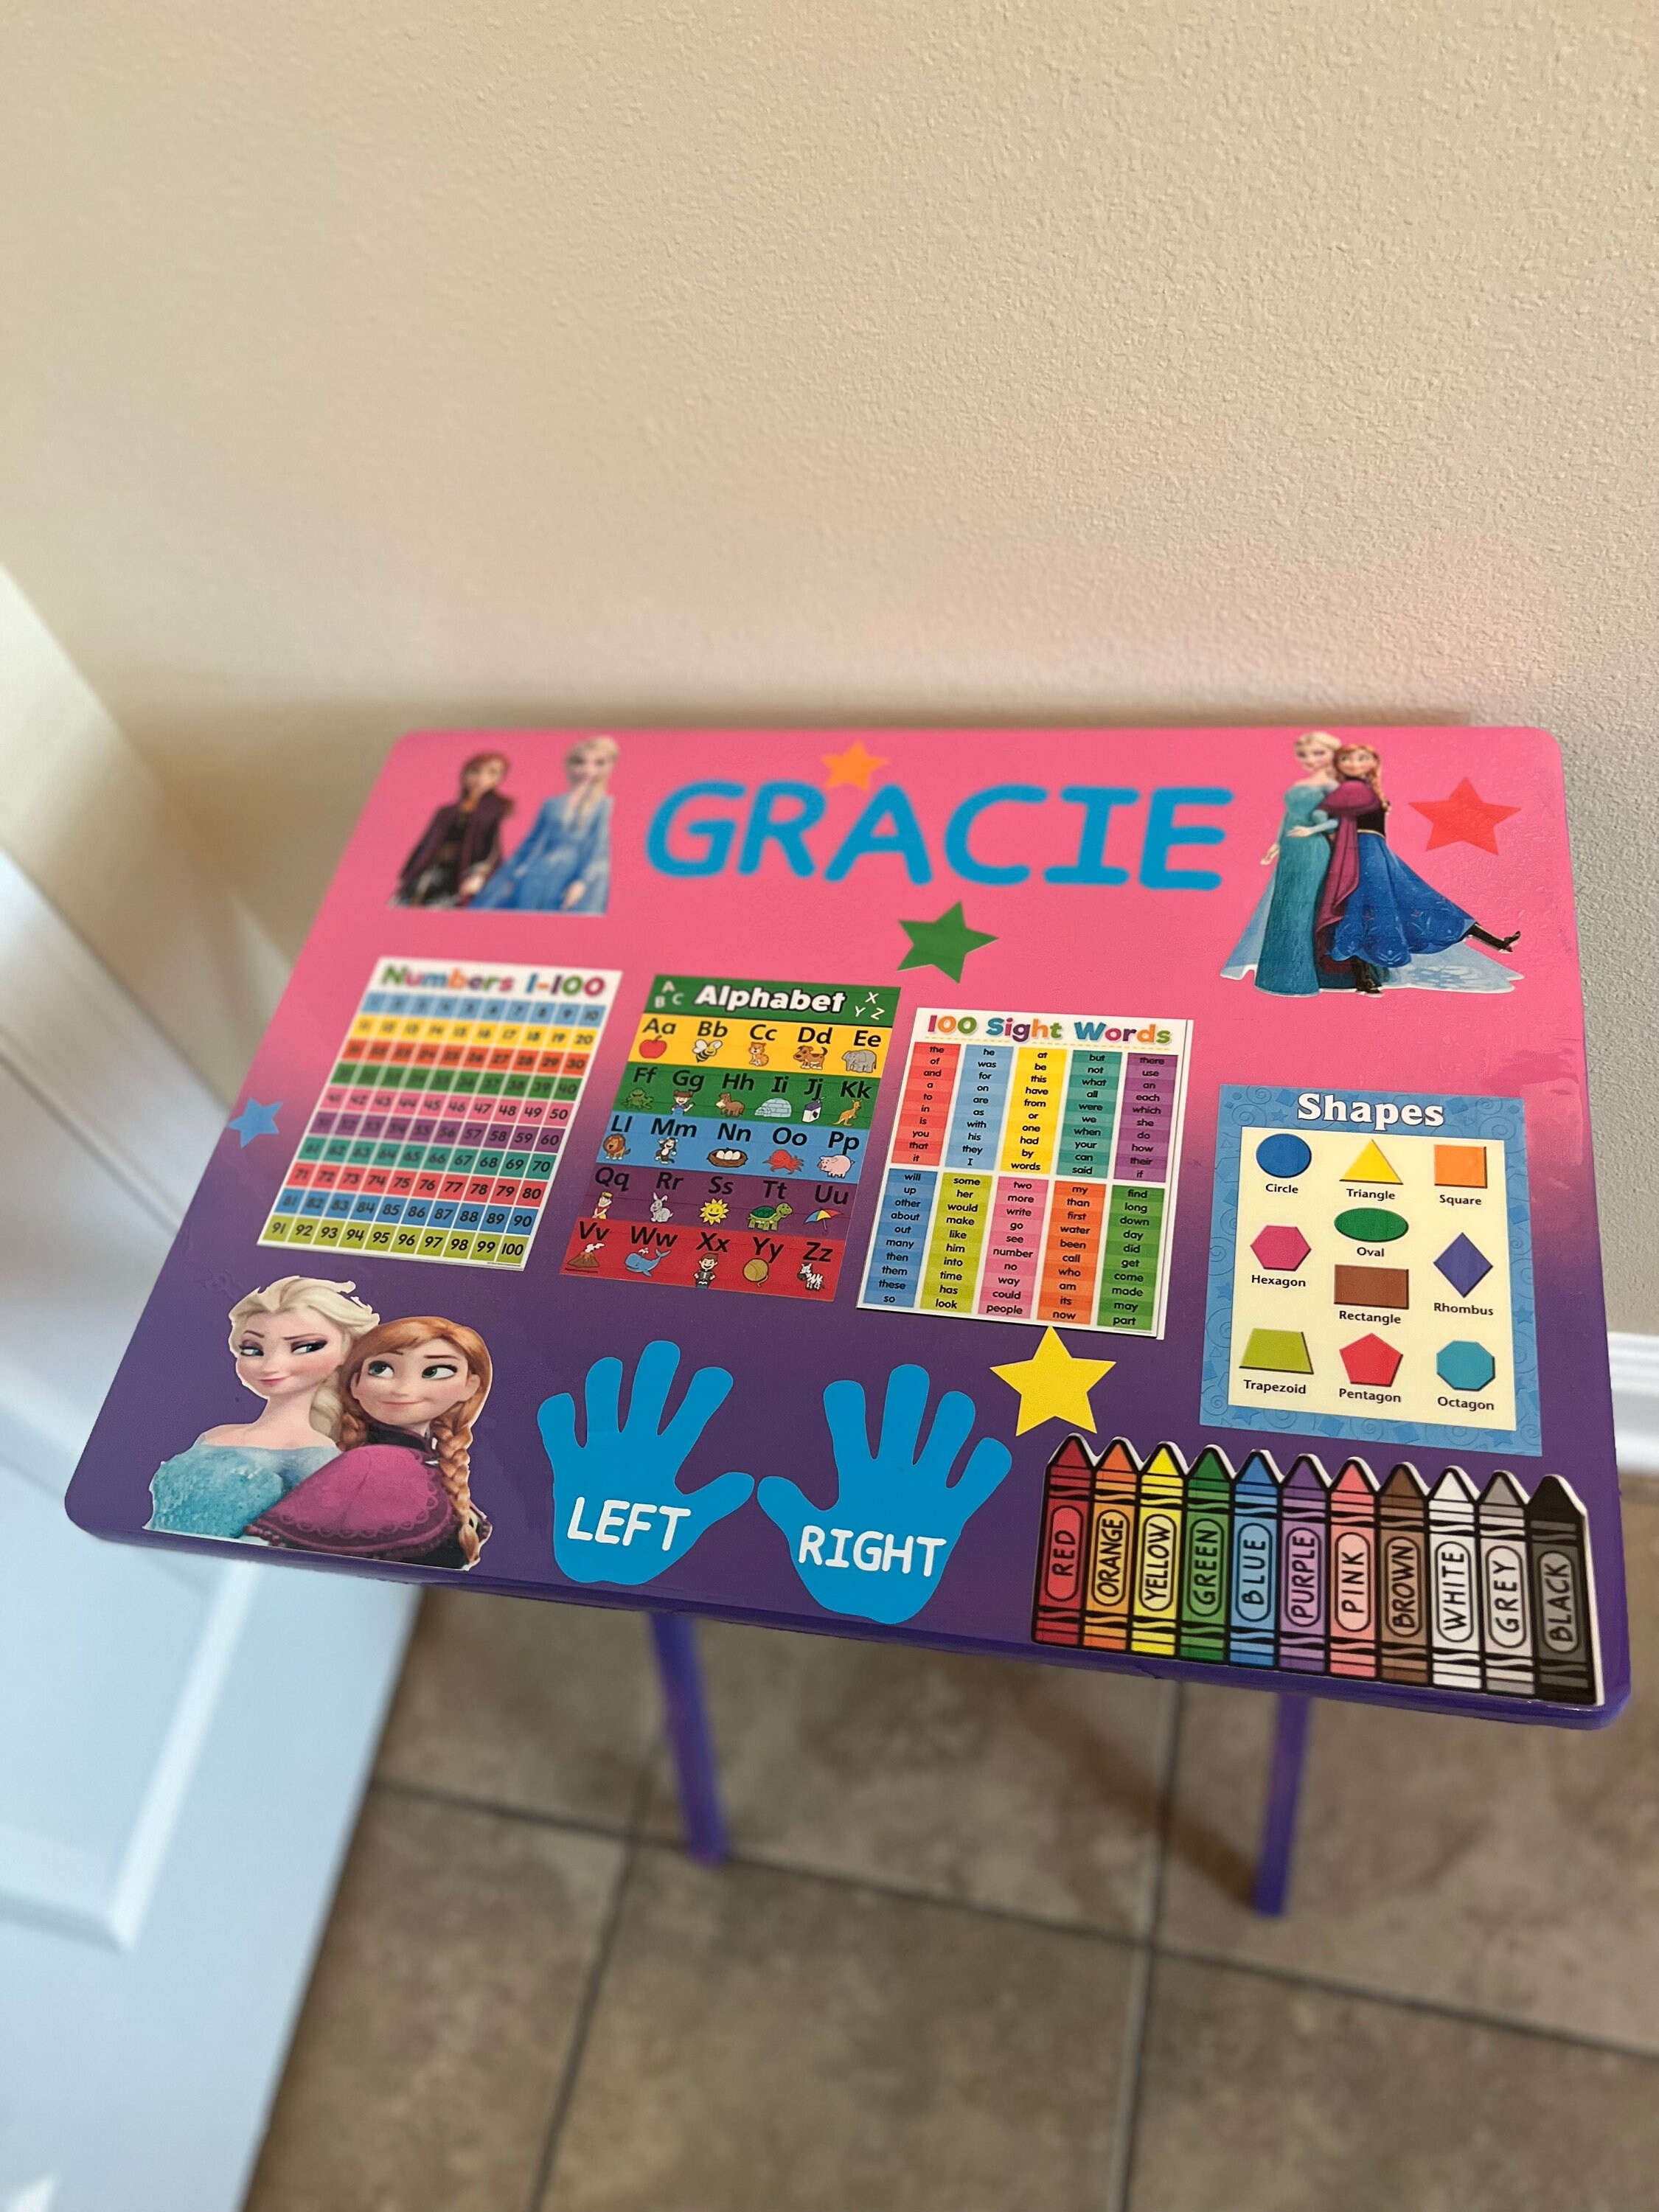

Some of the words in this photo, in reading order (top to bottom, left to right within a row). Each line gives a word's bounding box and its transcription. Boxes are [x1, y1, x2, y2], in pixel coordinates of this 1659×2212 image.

[645, 778, 1234, 891] GRACIE
[381, 965, 513, 992] Numbers
[525, 971, 605, 995] 1-100
[662, 981, 675, 993] A
[655, 997, 664, 1008] B
[672, 992, 684, 1004] C
[695, 984, 845, 1013] Alphabet
[866, 992, 879, 1004] X
[584, 1010, 600, 1022] 10
[854, 1006, 866, 1018] Y
[871, 1007, 884, 1020] Z
[642, 1018, 676, 1034] Aa
[698, 1021, 728, 1037] Bb
[750, 1025, 777, 1041] Cc
[797, 1027, 832, 1044] Dd
[854, 1031, 881, 1047] Ee
[927, 1015, 977, 1034] 100
[987, 1018, 1063, 1042] Sight
[1074, 1021, 1171, 1044] Words
[574, 1034, 594, 1046] 20
[1034, 1062, 1047, 1071] be
[633, 1068, 656, 1084] Ff
[672, 1071, 705, 1091] Gg
[722, 1073, 754, 1091] Hh
[771, 1077, 789, 1093] Ii
[804, 1079, 824, 1099] Jj
[841, 1082, 871, 1099] Kk
[1030, 1074, 1047, 1083] this
[1025, 1086, 1049, 1096] have
[1023, 1098, 1046, 1107] from
[549, 1108, 568, 1120] 50
[1296, 1092, 1445, 1131] Shapes
[967, 1119, 987, 1129] with
[540, 1134, 560, 1146] 60
[611, 1116, 632, 1133] Ll
[651, 1119, 697, 1137] Mm
[717, 1124, 751, 1141] Nn
[773, 1128, 807, 1145] Oo
[828, 1131, 859, 1155] Pp
[1020, 1135, 1040, 1145] had
[961, 1144, 984, 1156] they
[1021, 1148, 1034, 1159] by
[505, 1158, 524, 1170] 69
[532, 1160, 551, 1172] 70
[1010, 1162, 1041, 1171] words
[1071, 1166, 1093, 1175] said
[904, 1172, 922, 1181] will
[953, 1178, 981, 1186] some
[595, 1167, 630, 1191] Qq
[657, 1173, 683, 1190] Rr
[709, 1178, 733, 1194] Ss
[763, 1181, 787, 1200] Tt
[815, 1186, 849, 1204] Uu
[1013, 1180, 1032, 1190] two
[1071, 1186, 1088, 1195] my
[1265, 1183, 1298, 1194] Circle
[470, 1183, 489, 1195] 78
[495, 1185, 515, 1197] 79
[522, 1187, 542, 1200] 80
[903, 1187, 917, 1196] up
[956, 1189, 974, 1199] her
[1127, 1189, 1148, 1199] find
[1346, 1189, 1396, 1200] Triangle
[894, 1197, 922, 1208] other
[1007, 1194, 1034, 1203] more
[1066, 1197, 1091, 1208] than
[1439, 1194, 1482, 1206] Square
[947, 1203, 978, 1213] would
[1006, 1207, 1032, 1217] write
[1124, 1202, 1148, 1214] long
[407, 1206, 425, 1218] 86
[434, 1208, 453, 1220] 87
[459, 1210, 479, 1223] 88
[486, 1212, 505, 1225] 89
[513, 1214, 532, 1228] 90
[890, 1211, 920, 1221] about
[945, 1216, 975, 1226] make
[1067, 1211, 1087, 1221] first
[1119, 1215, 1150, 1226] down
[894, 1225, 912, 1234] out
[1009, 1222, 1024, 1231] go
[1060, 1225, 1091, 1235] water
[272, 1222, 286, 1234] 91
[296, 1224, 313, 1237] 92
[321, 1226, 338, 1239] 93
[346, 1228, 365, 1242] 94
[372, 1231, 391, 1244] 95
[397, 1233, 416, 1246] 96
[424, 1235, 444, 1248] 97
[451, 1238, 469, 1251] 98
[476, 1240, 496, 1253] 99
[501, 1242, 524, 1256] 100
[949, 1229, 967, 1239] like
[1122, 1229, 1144, 1242] day
[580, 1223, 610, 1240] Vv
[630, 1226, 678, 1247] Ww
[697, 1233, 730, 1252] Xx
[753, 1237, 784, 1263] Yy
[803, 1242, 833, 1262] Zz
[886, 1239, 915, 1250] many
[1005, 1236, 1024, 1244] see
[1060, 1239, 1087, 1250] been
[945, 1242, 966, 1253] him
[992, 1248, 1034, 1258] number
[1122, 1243, 1141, 1253] did
[1357, 1247, 1385, 1258] Oval
[886, 1251, 909, 1262] then
[943, 1256, 964, 1267] into
[1062, 1253, 1081, 1263] call
[1004, 1263, 1018, 1271] no
[1121, 1259, 1140, 1269] get
[882, 1265, 908, 1276] them
[939, 1270, 963, 1281] time
[1058, 1267, 1081, 1277] who
[998, 1277, 1020, 1287] way
[1113, 1273, 1144, 1282] come
[1251, 1274, 1306, 1287] Hexagon
[878, 1279, 907, 1290] these
[939, 1284, 959, 1295] has
[1059, 1283, 1077, 1291] am
[992, 1290, 1021, 1300] could
[1111, 1287, 1144, 1297] made
[883, 1295, 896, 1306] so
[935, 1298, 958, 1310] look
[1060, 1297, 1072, 1306] its
[986, 1304, 1023, 1316] people
[1113, 1302, 1139, 1313] may
[1433, 1303, 1494, 1316] Rhombus
[1052, 1311, 1077, 1320] now
[1339, 1310, 1402, 1325] Rectangle
[1112, 1317, 1137, 1329] part
[1243, 1380, 1307, 1394] Trapezoid
[1339, 1388, 1402, 1403] Pentagon
[1437, 1397, 1495, 1411] Octagon
[567, 1497, 691, 1551] LEFT
[799, 1526, 946, 1576] RIGHT
[1054, 1530, 1076, 1575] RED
[1097, 1517, 1124, 1595] ORANGE
[1144, 1524, 1172, 1601] YELLOW
[1195, 1531, 1218, 1604] GREEN
[1242, 1539, 1266, 1604] BLUE
[1290, 1534, 1316, 1619] PURPLE
[1342, 1552, 1366, 1613] PINK
[1392, 1545, 1416, 1627] BROWN
[1443, 1548, 1467, 1630] WHITE
[1493, 1560, 1517, 1632] GREY
[1548, 1565, 1571, 1640] BLACK
